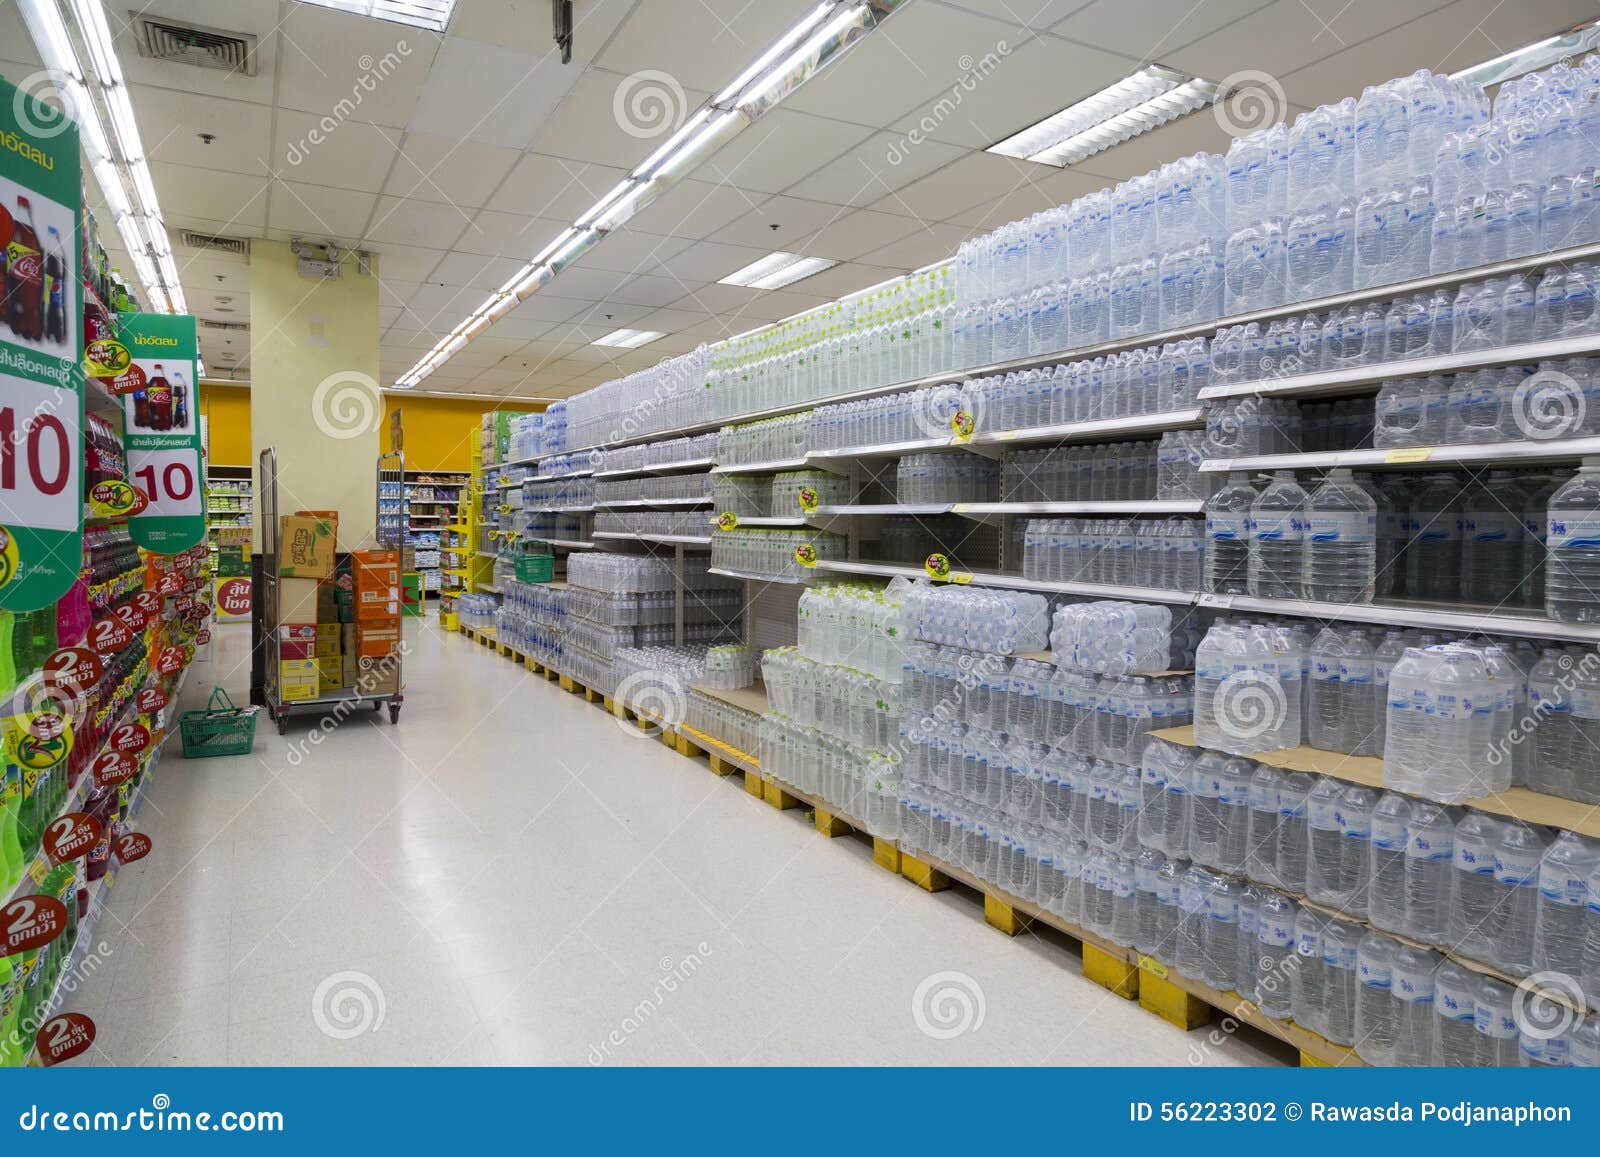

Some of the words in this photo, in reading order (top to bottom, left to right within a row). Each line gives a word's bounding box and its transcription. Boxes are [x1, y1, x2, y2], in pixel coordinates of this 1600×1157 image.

[0, 130, 54, 170] ำอัดลม
[0, 407, 70, 496] 10
[135, 463, 193, 502] 10
[137, 593, 150, 607] 2
[117, 606, 132, 622] 2
[95, 621, 114, 641] 2
[54, 652, 78, 678] 2
[162, 656, 172, 667] 2
[142, 689, 155, 704] 2
[118, 726, 134, 743] 2
[102, 753, 120, 772] 2
[52, 818, 76, 847] 2
[120, 835, 135, 852] 2
[7, 900, 35, 934] 2
[9, 920, 56, 947] ถูกกว่า
[45, 1018, 70, 1047] 2
